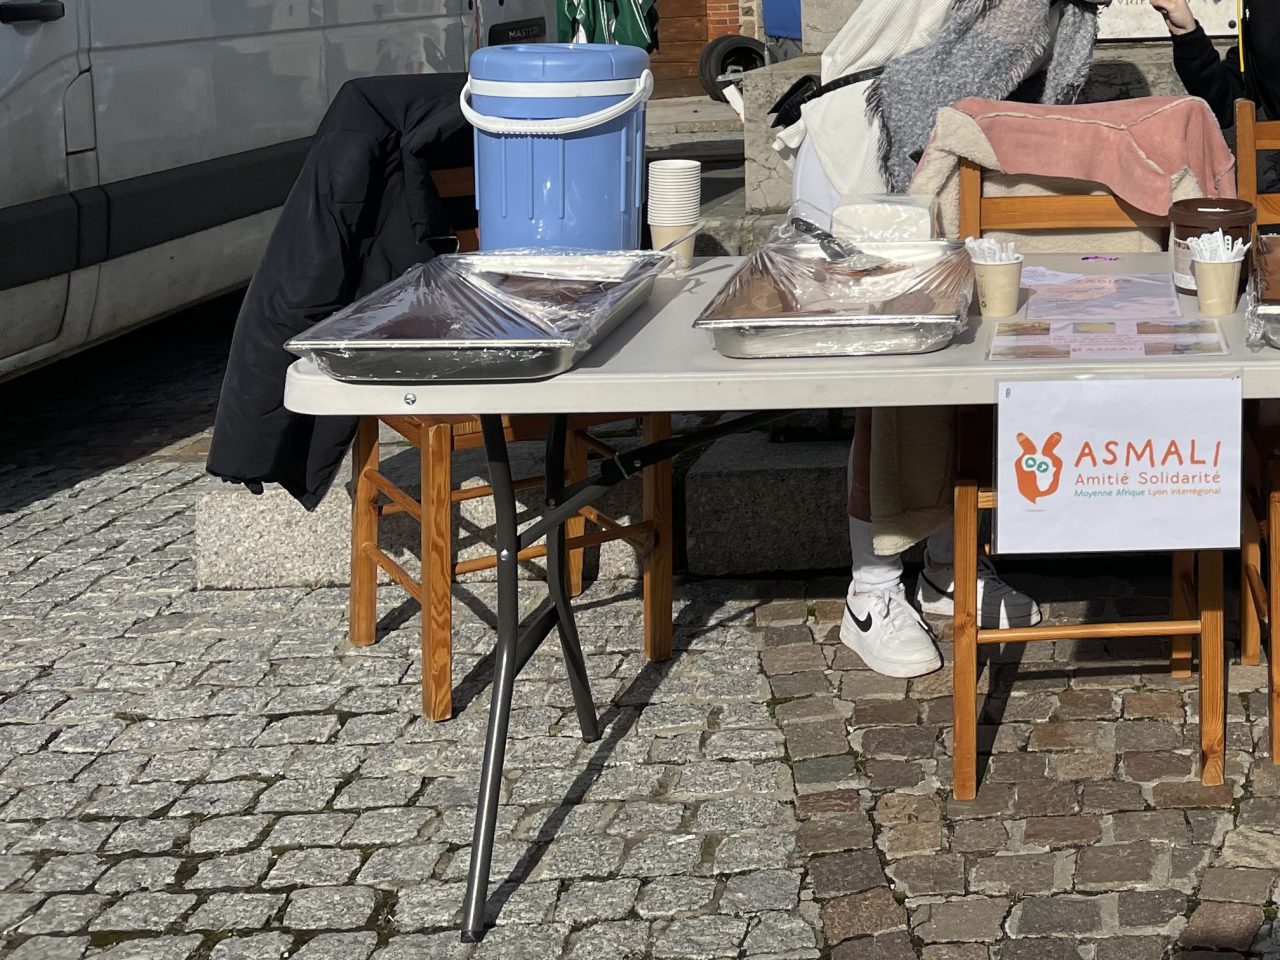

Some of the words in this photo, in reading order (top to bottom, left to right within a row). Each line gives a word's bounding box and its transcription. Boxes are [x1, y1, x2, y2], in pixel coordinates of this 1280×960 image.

[1074, 439, 1222, 468] ASMALI
[1074, 472, 1129, 486] Amitié
[1138, 471, 1221, 485] Solidarité
[1074, 489, 1113, 498] Moyenne
[1115, 488, 1146, 498] Afrique
[1148, 488, 1169, 497] Lyon
